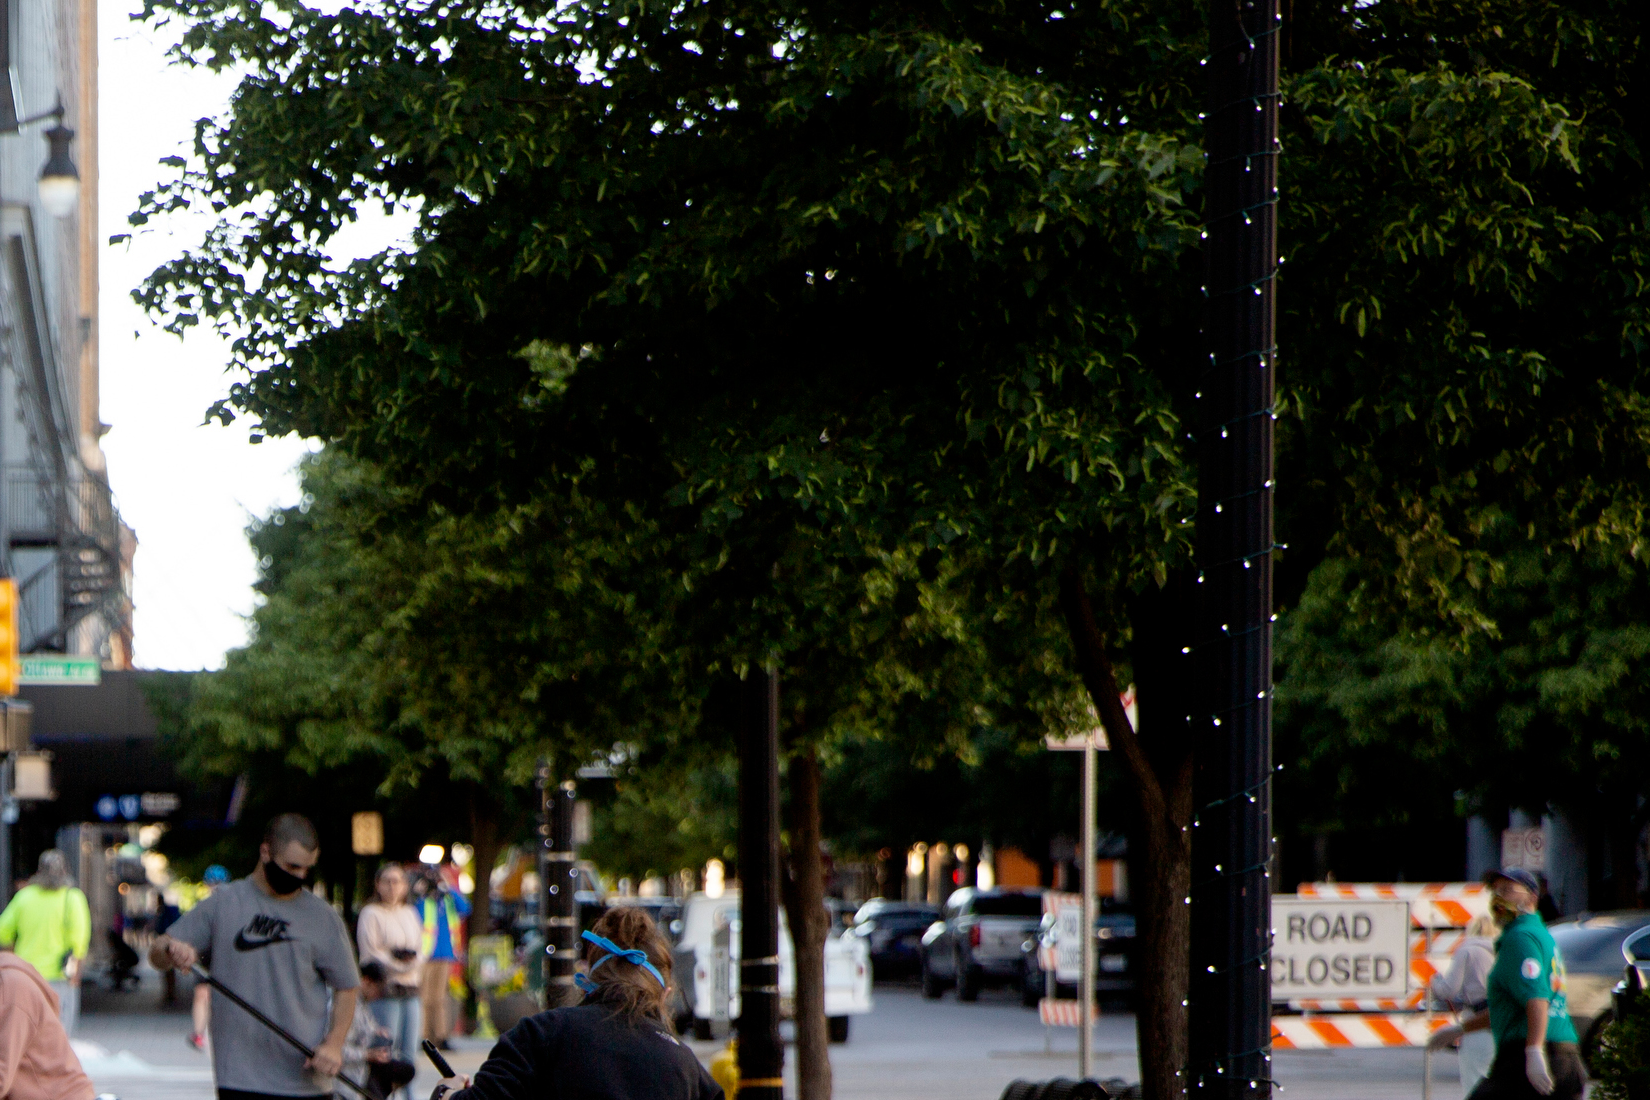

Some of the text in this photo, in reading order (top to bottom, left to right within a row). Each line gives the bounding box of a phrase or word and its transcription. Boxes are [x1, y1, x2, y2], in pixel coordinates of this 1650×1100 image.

[246, 914, 290, 938] NIKE
[1286, 912, 1372, 943] ROAD
[1271, 954, 1393, 985] CLOSED
